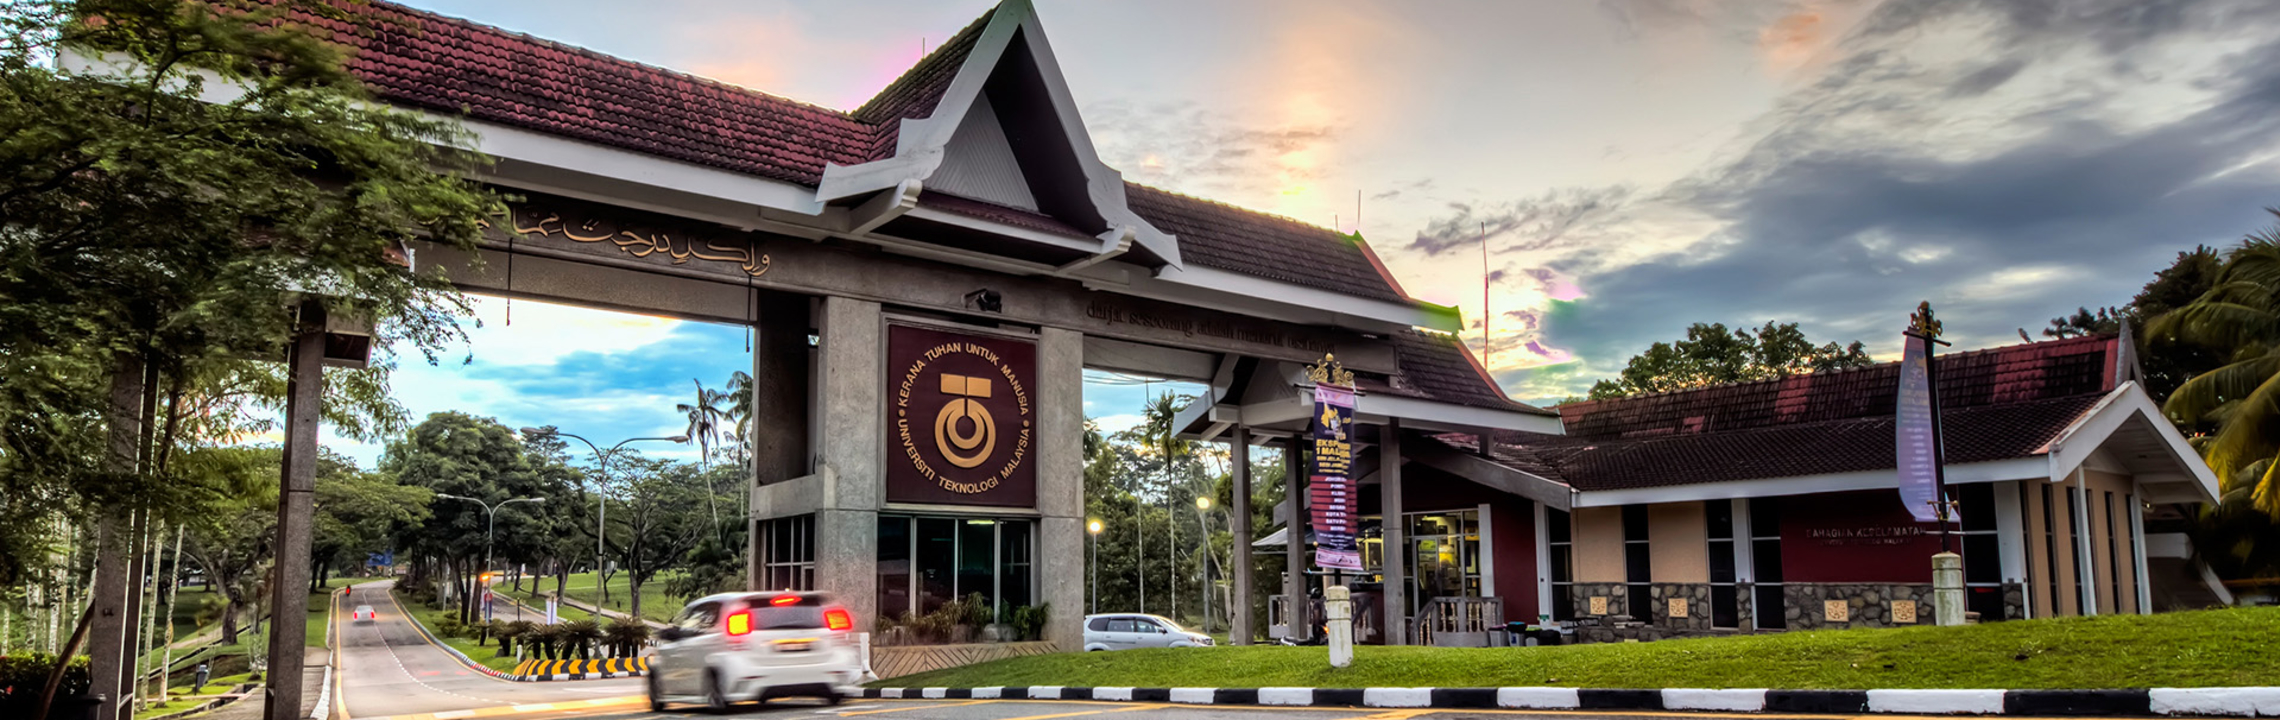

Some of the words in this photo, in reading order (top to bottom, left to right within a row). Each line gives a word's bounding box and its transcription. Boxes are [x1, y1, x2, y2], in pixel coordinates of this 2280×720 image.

[1129, 310, 1192, 337] seseorang
[897, 359, 926, 408] KERANA
[924, 342, 961, 362] TUHAN
[965, 343, 1000, 366] UNTUK
[1000, 364, 1029, 416] MANUSIA
[897, 418, 936, 481] UNIVERSITI
[938, 475, 999, 494] TEKNOLOGI
[1000, 428, 1030, 480] MALAYSIA
